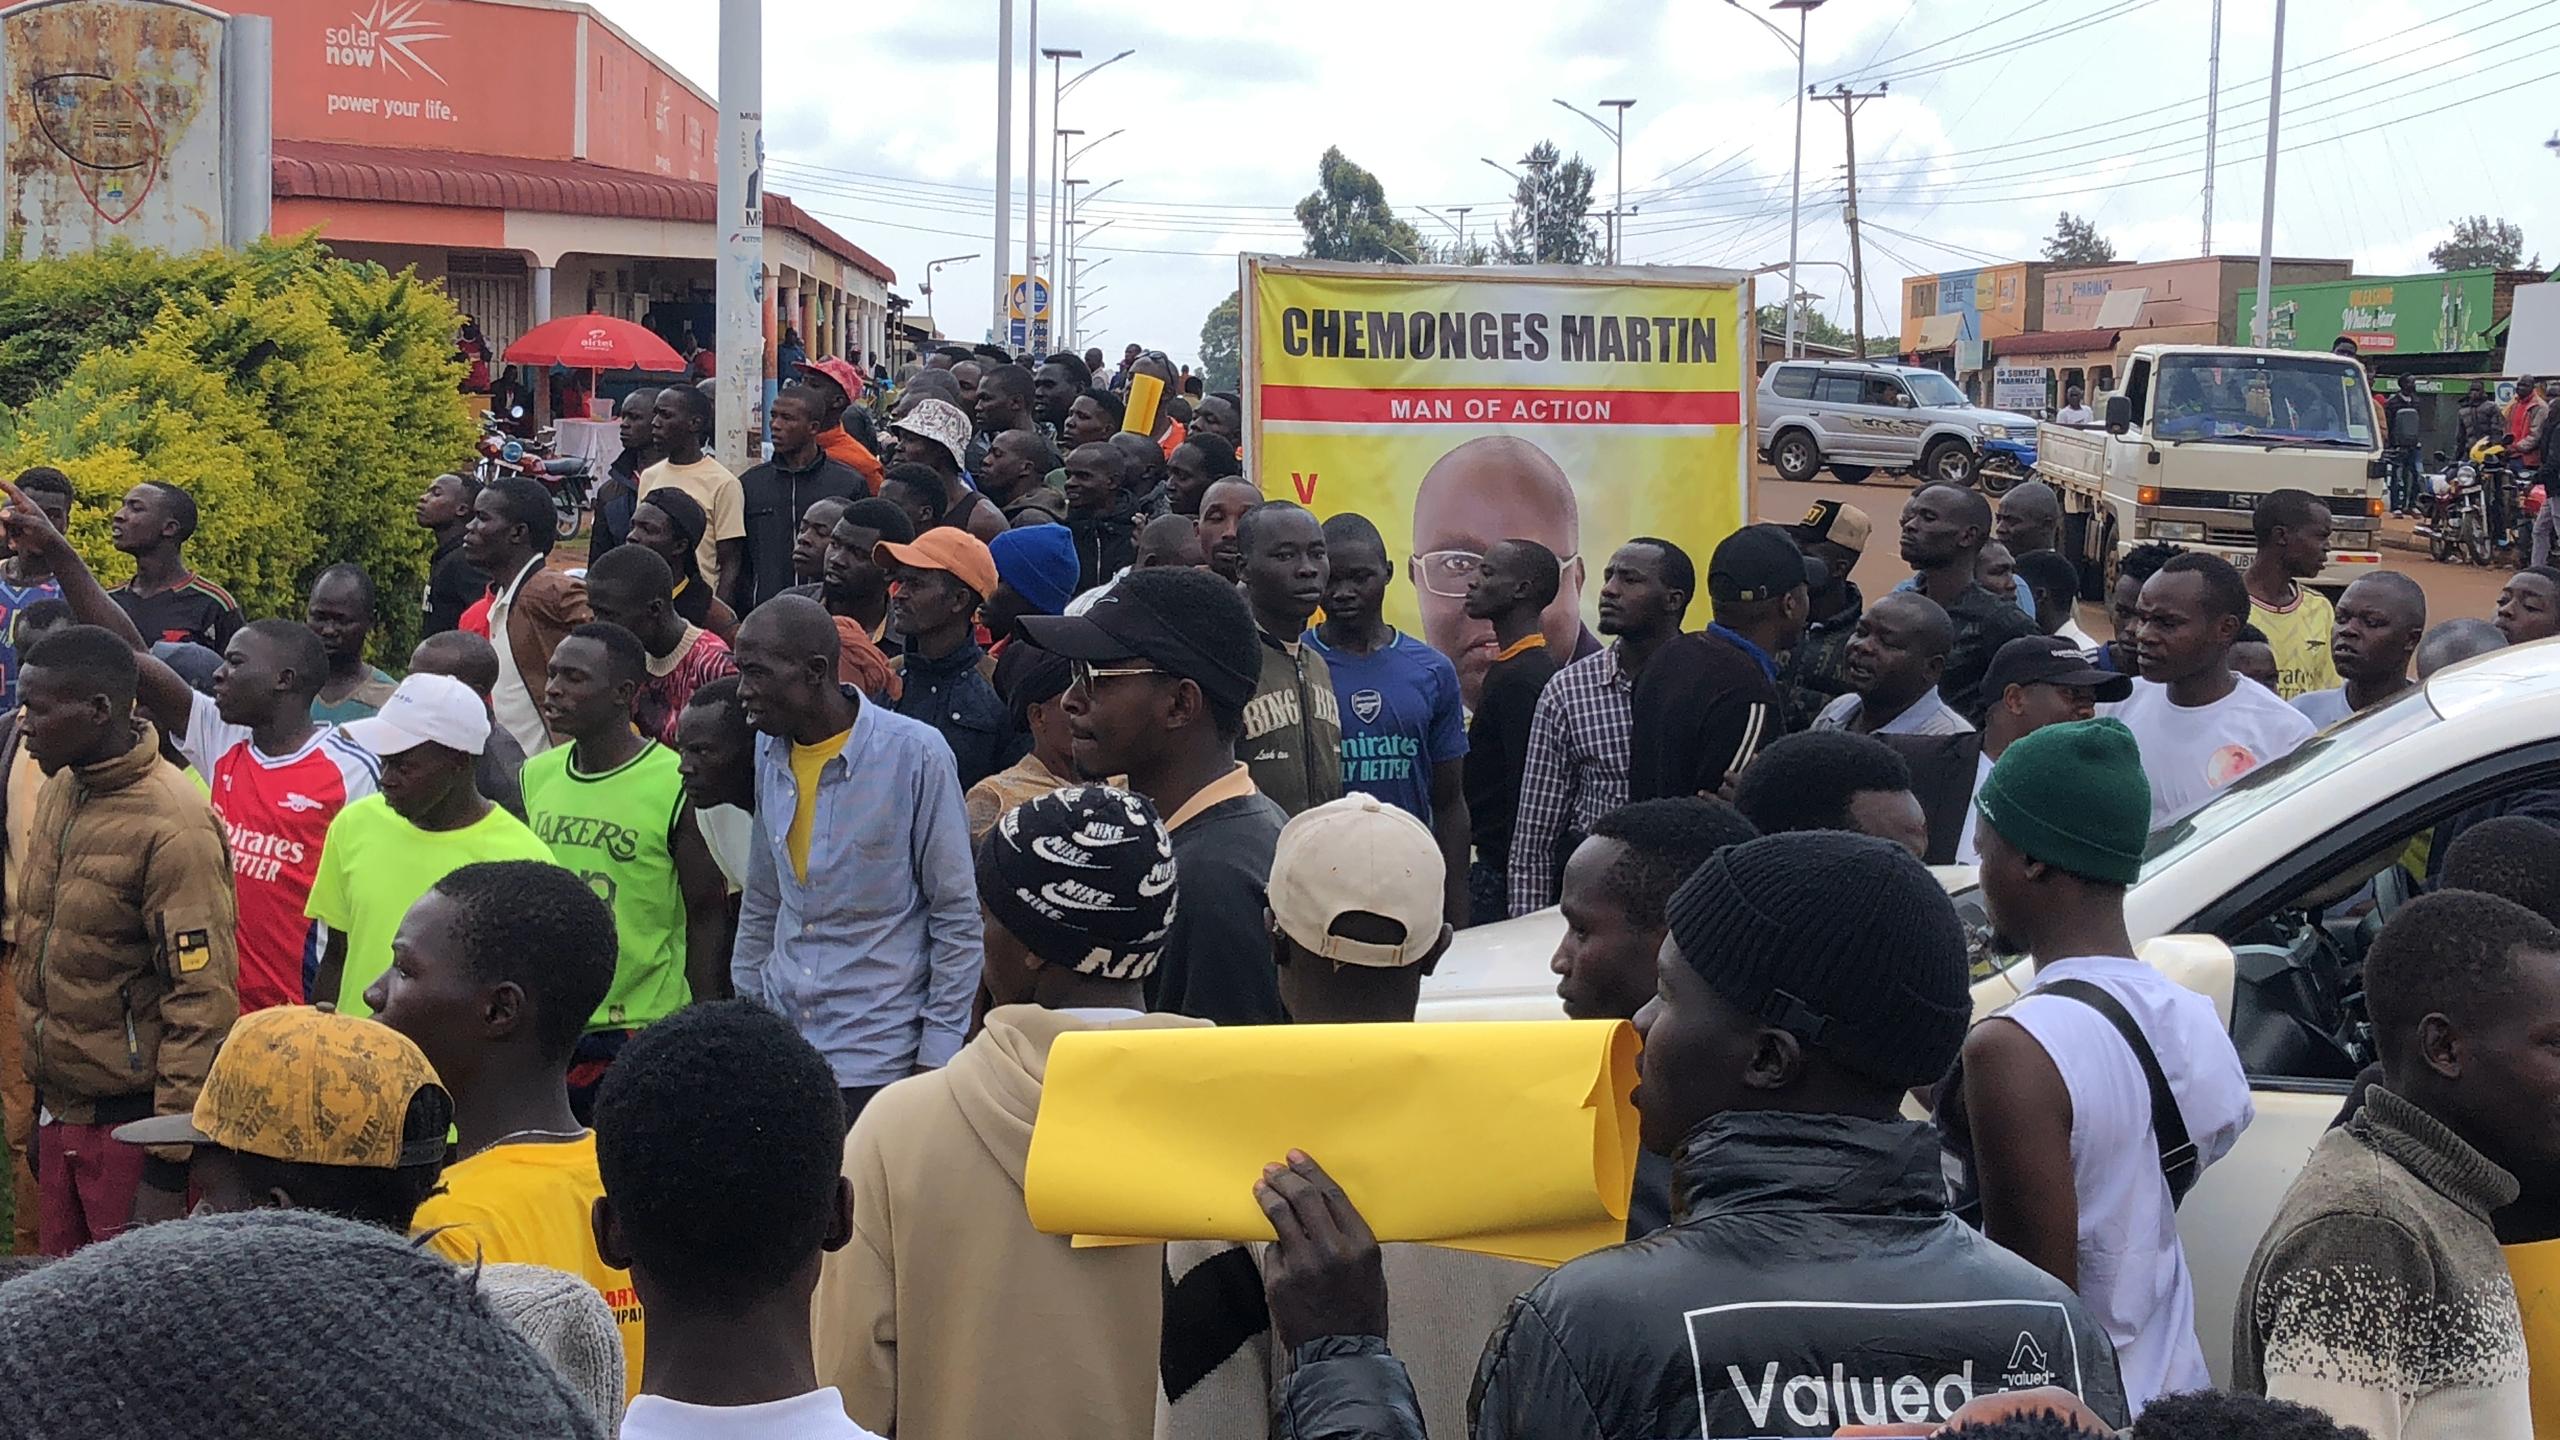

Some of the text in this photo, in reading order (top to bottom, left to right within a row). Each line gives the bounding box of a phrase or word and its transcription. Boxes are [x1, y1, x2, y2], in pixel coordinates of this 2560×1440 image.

[325, 23, 379, 47] solar
[326, 45, 374, 67] now
[327, 94, 458, 121] power your life.
[2342, 306, 2373, 330] White
[1282, 307, 1717, 364] CHEMONGES MARTIN
[1390, 399, 1611, 420] MAN OF ACTION
[1360, 758, 1411, 781] BETTER
[1083, 821, 1125, 841] NIKE
[1047, 836, 1094, 864] NIKE
[230, 849, 282, 882] ETTER
[1055, 878, 1116, 906] NIKE
[1726, 1360, 1974, 1429] Valued
